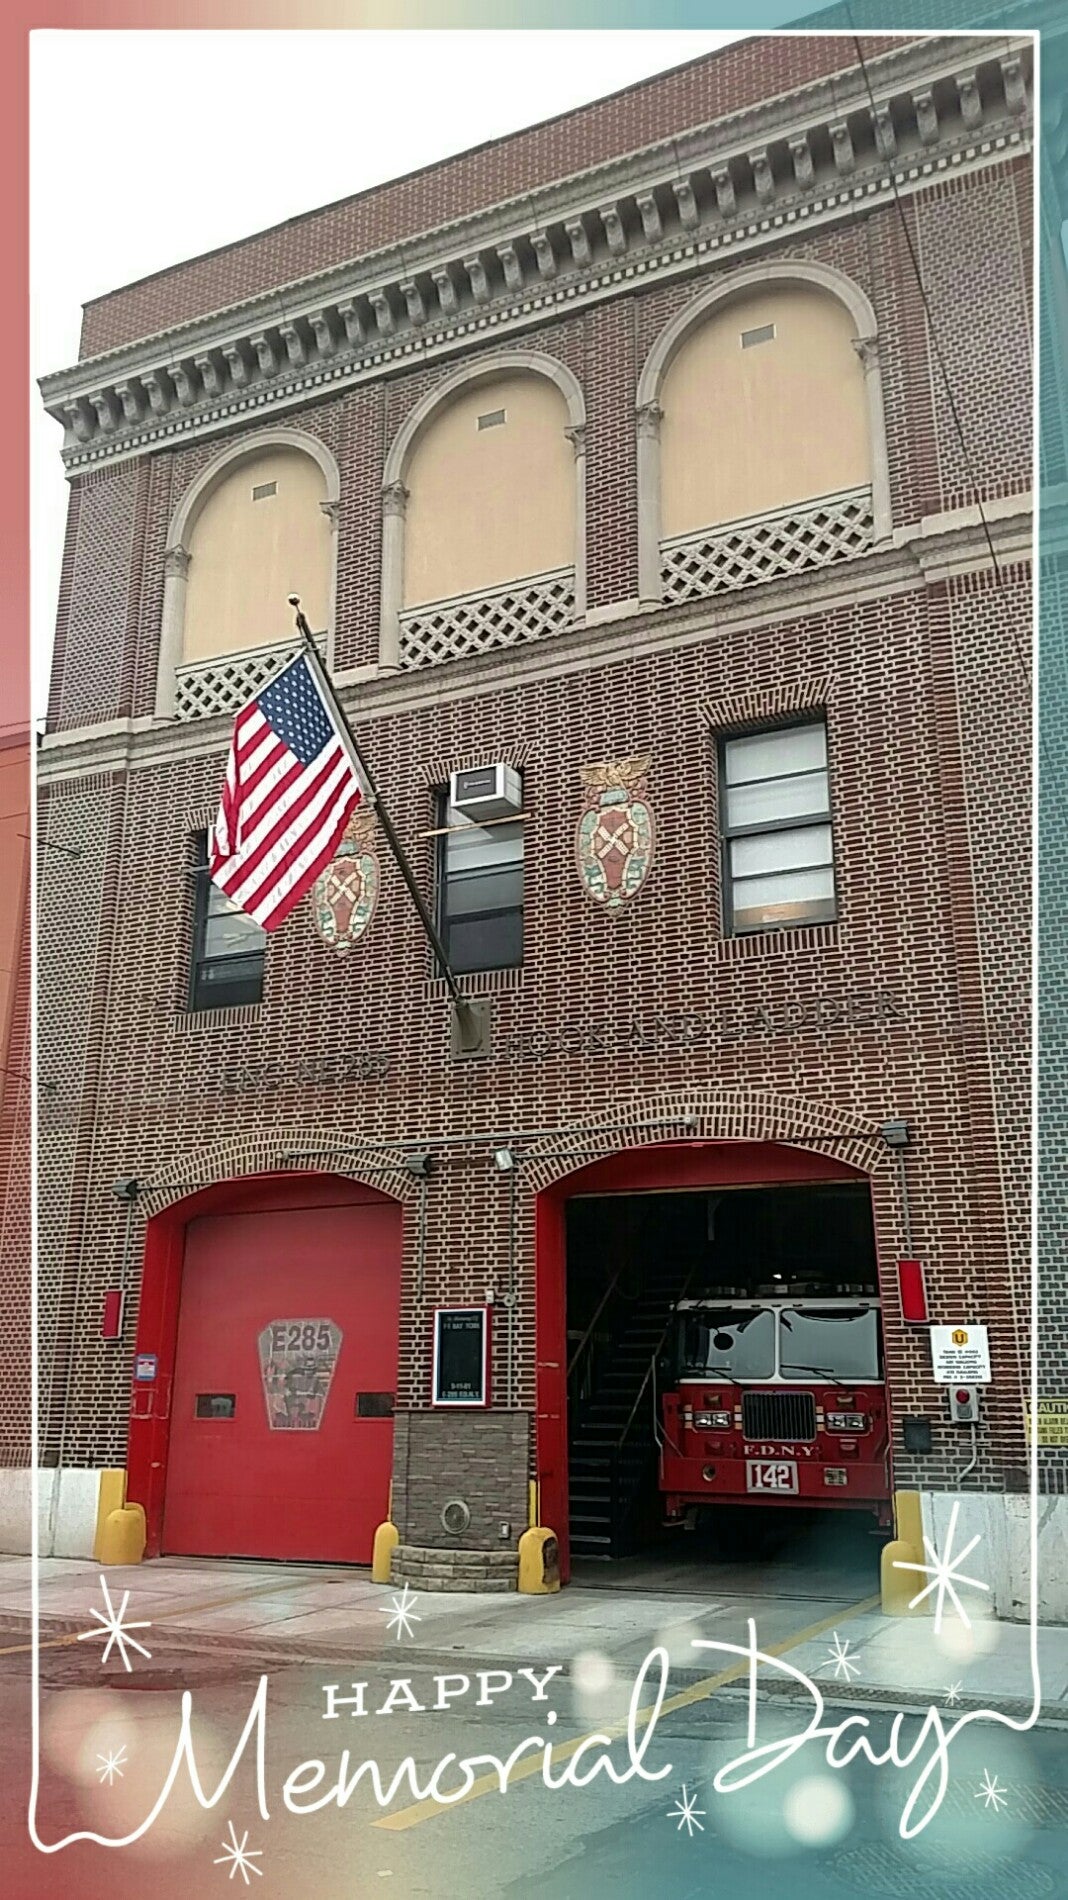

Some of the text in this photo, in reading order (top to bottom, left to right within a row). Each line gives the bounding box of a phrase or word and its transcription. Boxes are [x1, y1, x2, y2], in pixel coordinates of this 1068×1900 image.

[504, 990, 905, 1060] HOOK AND LADDER
[221, 1056, 336, 1094] ENGNE
[271, 1325, 331, 1352] E285
[1029, 1402, 1068, 1414] AUTI
[754, 1464, 792, 1489] 142
